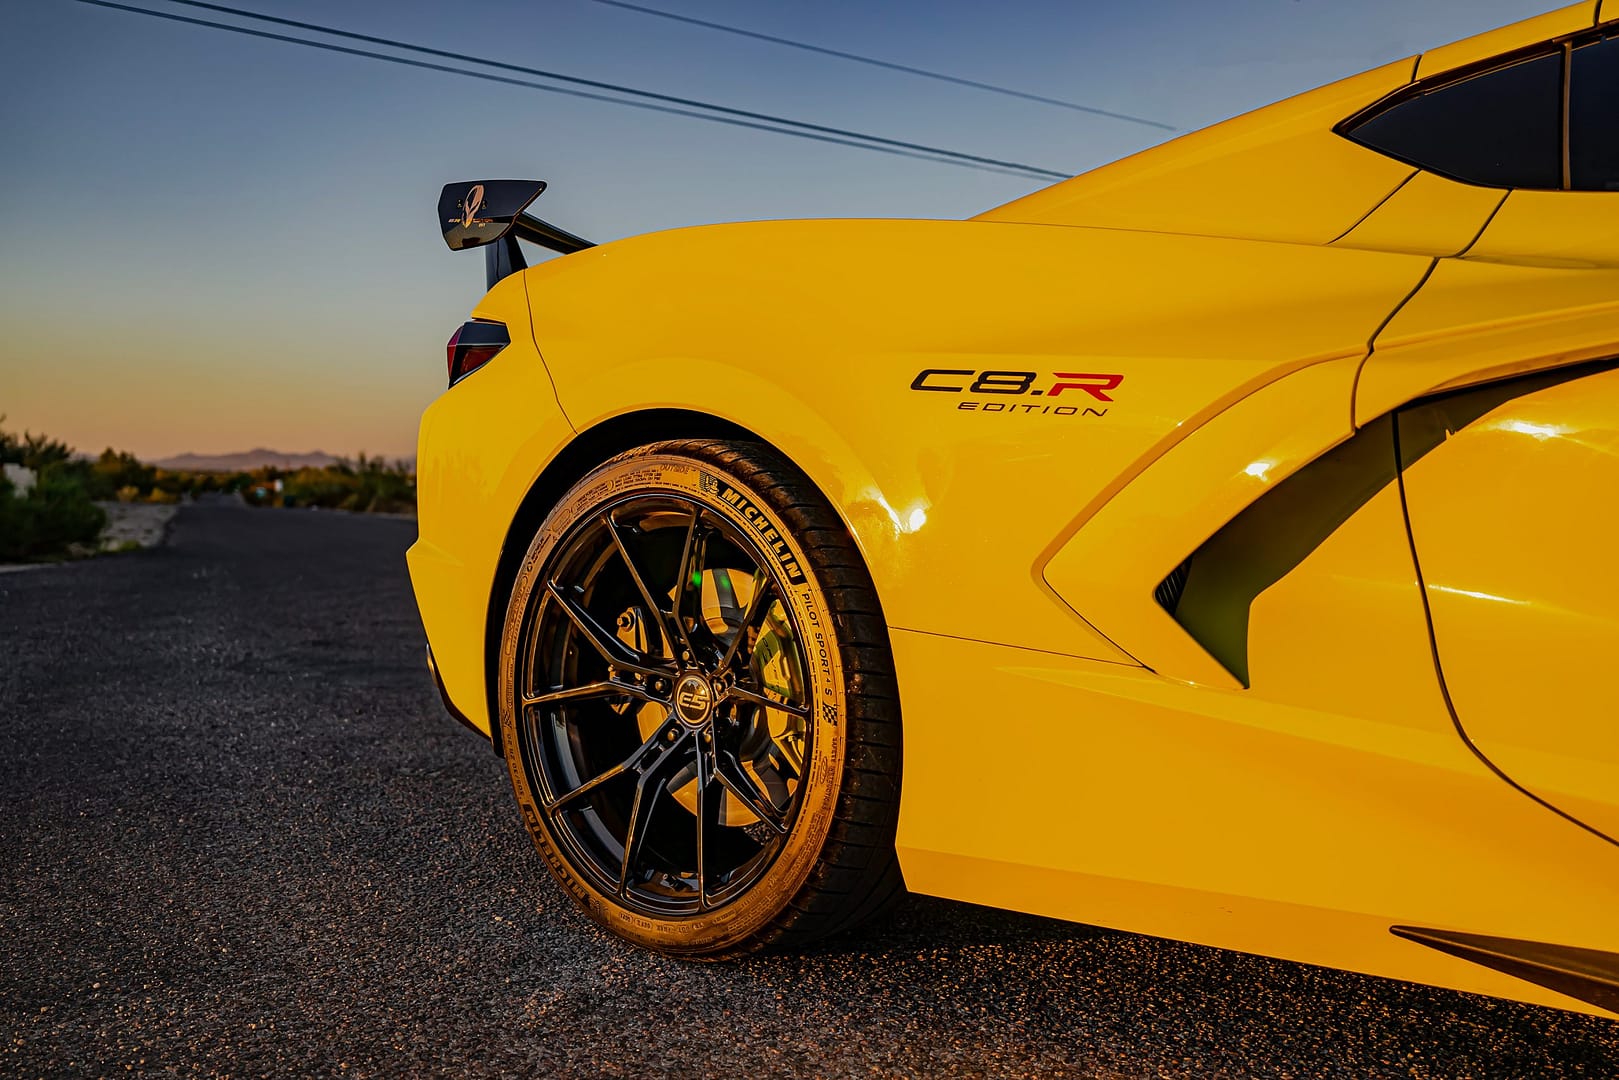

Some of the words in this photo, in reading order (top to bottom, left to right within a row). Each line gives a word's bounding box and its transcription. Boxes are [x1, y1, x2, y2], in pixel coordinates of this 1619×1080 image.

[910, 369, 1124, 402] C8.R
[957, 402, 1109, 417] EDITION
[721, 487, 802, 579] MICHELIN
[801, 592, 820, 628] PILOT
[815, 632, 831, 676] SPORT
[824, 687, 833, 697] S
[526, 810, 586, 900] MICHELIN
